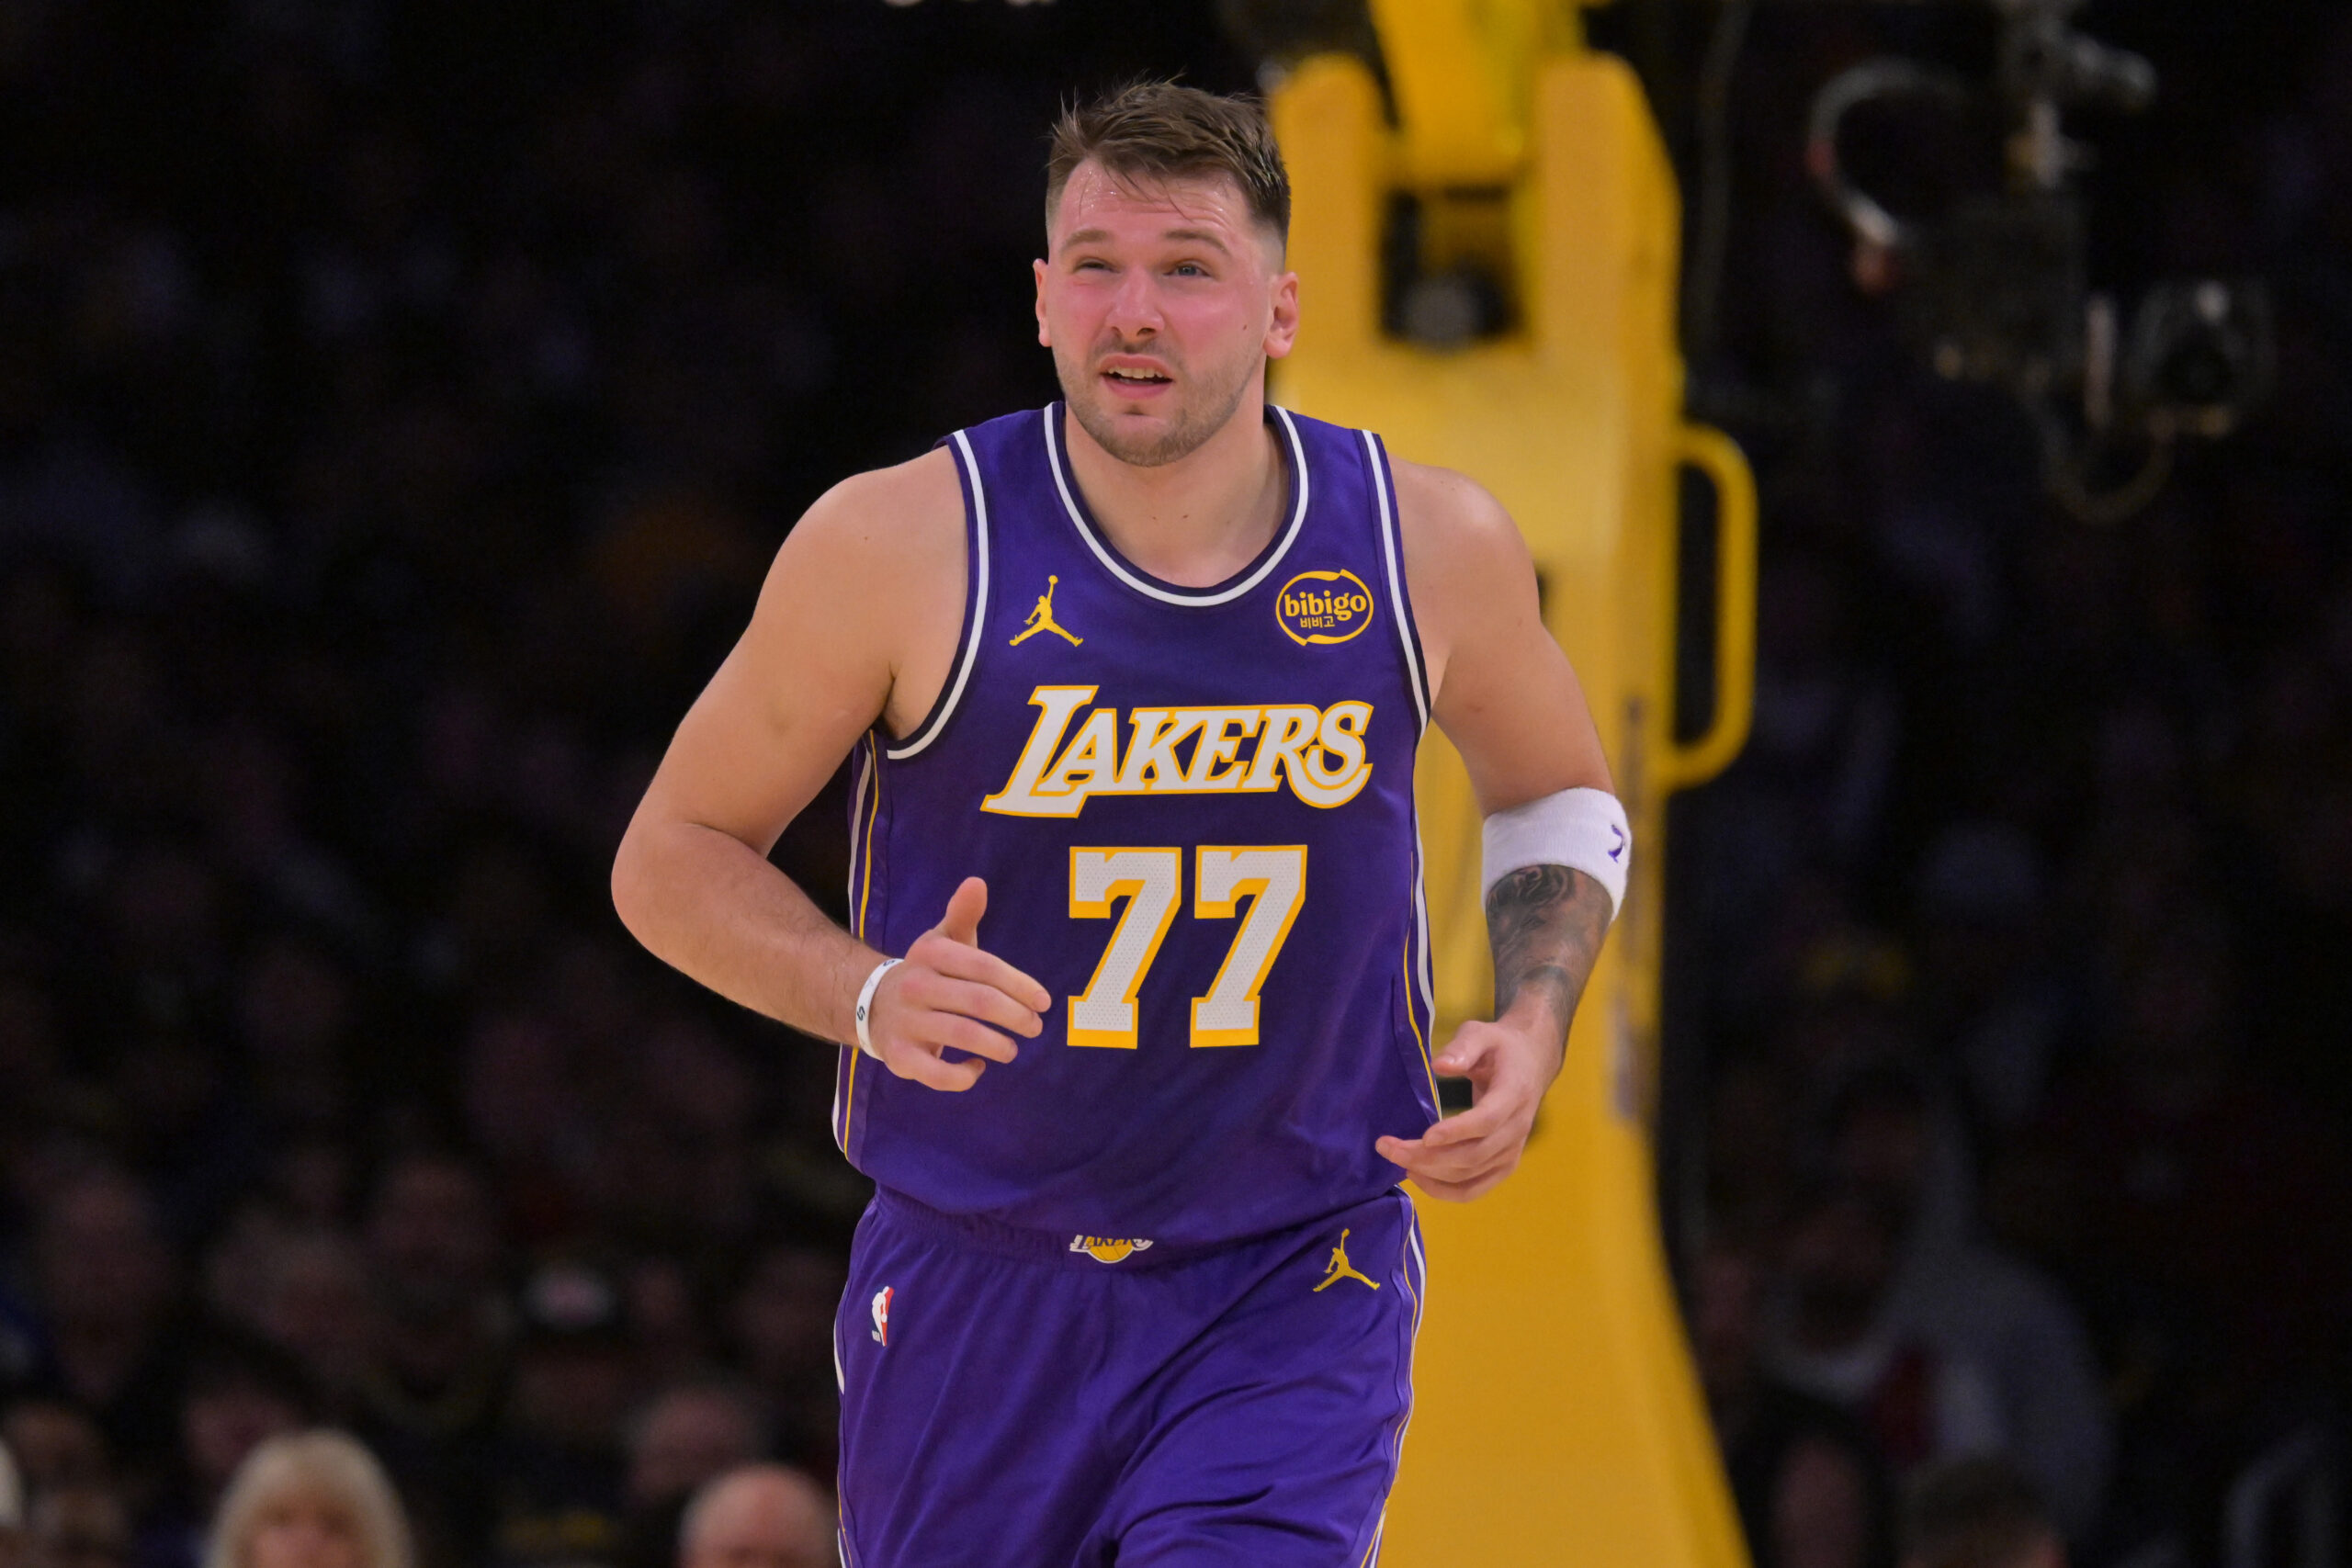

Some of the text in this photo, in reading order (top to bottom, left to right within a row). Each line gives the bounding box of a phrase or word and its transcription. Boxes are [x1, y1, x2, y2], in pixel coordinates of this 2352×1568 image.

[1284, 590, 1367, 621] bibigo
[1300, 615, 1335, 629] 비비고
[979, 684, 1374, 818] LAKERS
[1067, 844, 1308, 1049] 77
